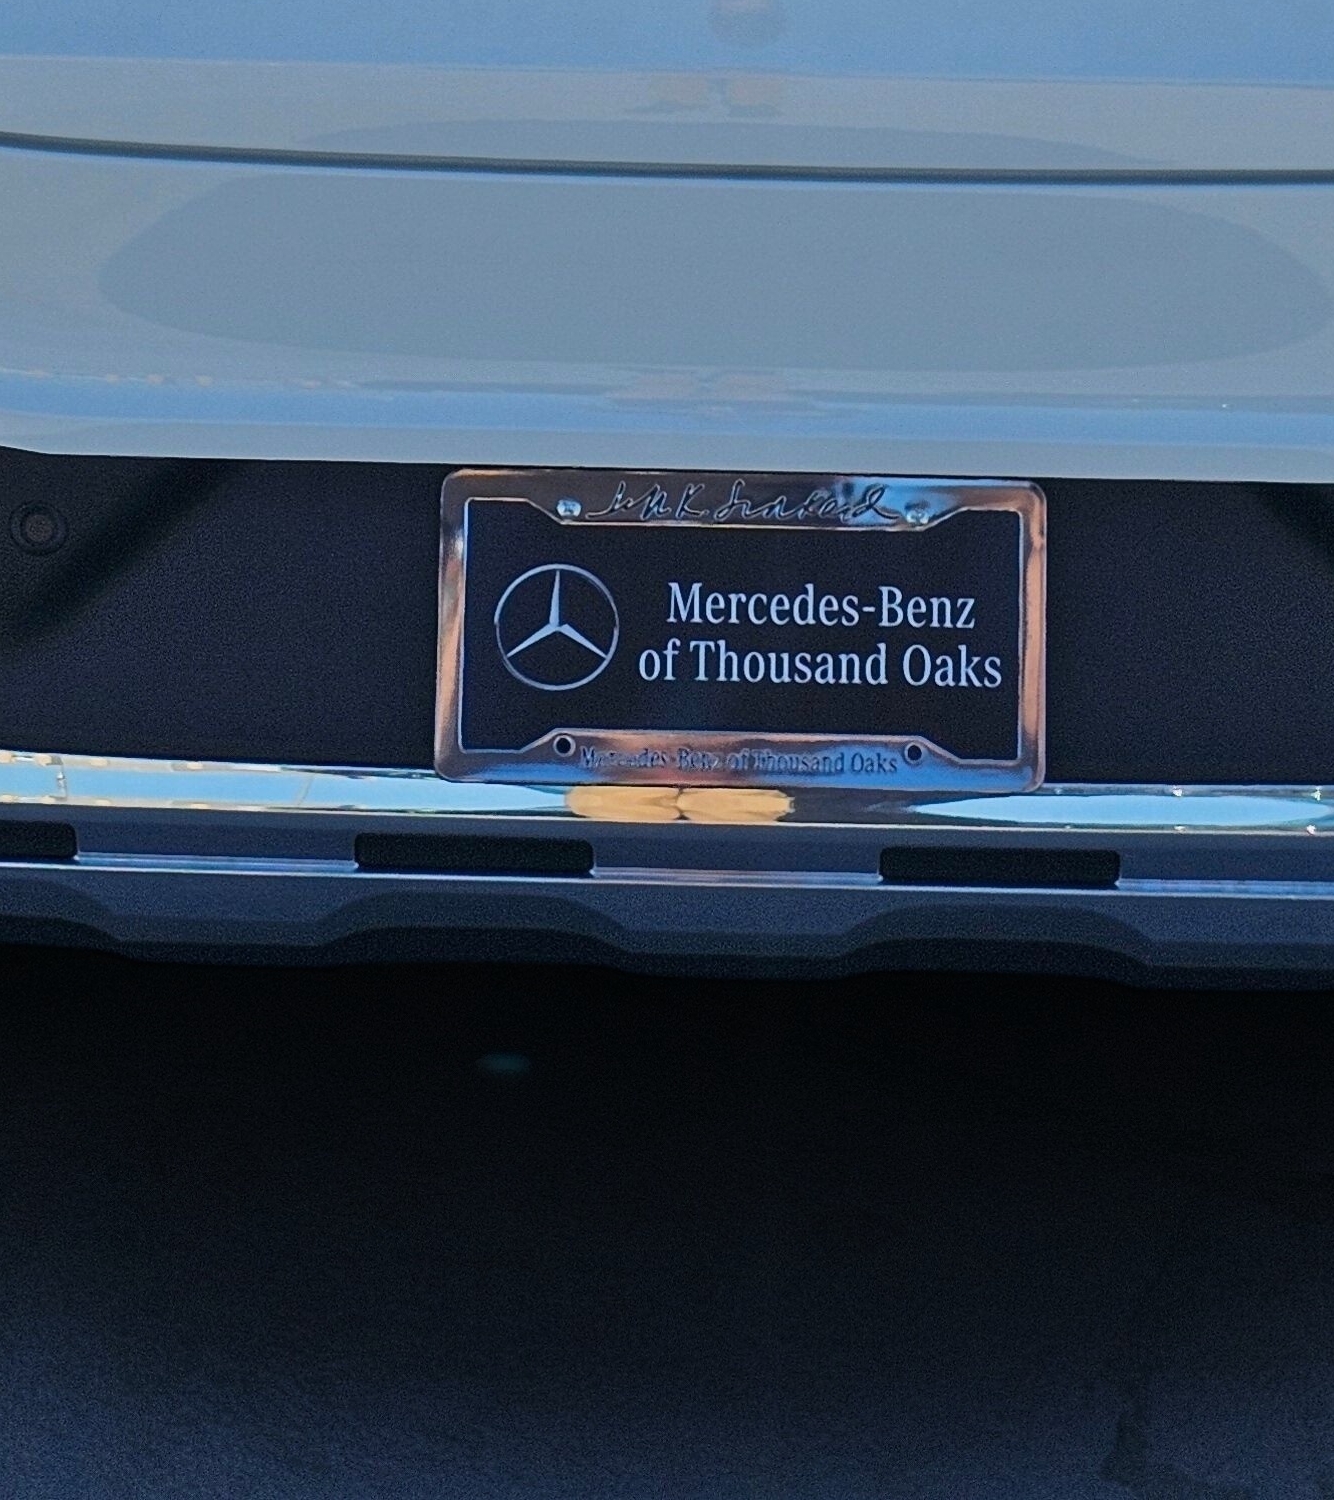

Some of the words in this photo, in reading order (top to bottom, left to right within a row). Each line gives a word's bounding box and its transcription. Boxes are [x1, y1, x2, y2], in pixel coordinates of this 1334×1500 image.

[666, 581, 976, 630] Mercedes-Benz
[638, 637, 682, 682] of
[688, 639, 890, 686] Thousand
[901, 643, 1003, 689] Oaks
[851, 752, 898, 774] Oaks
